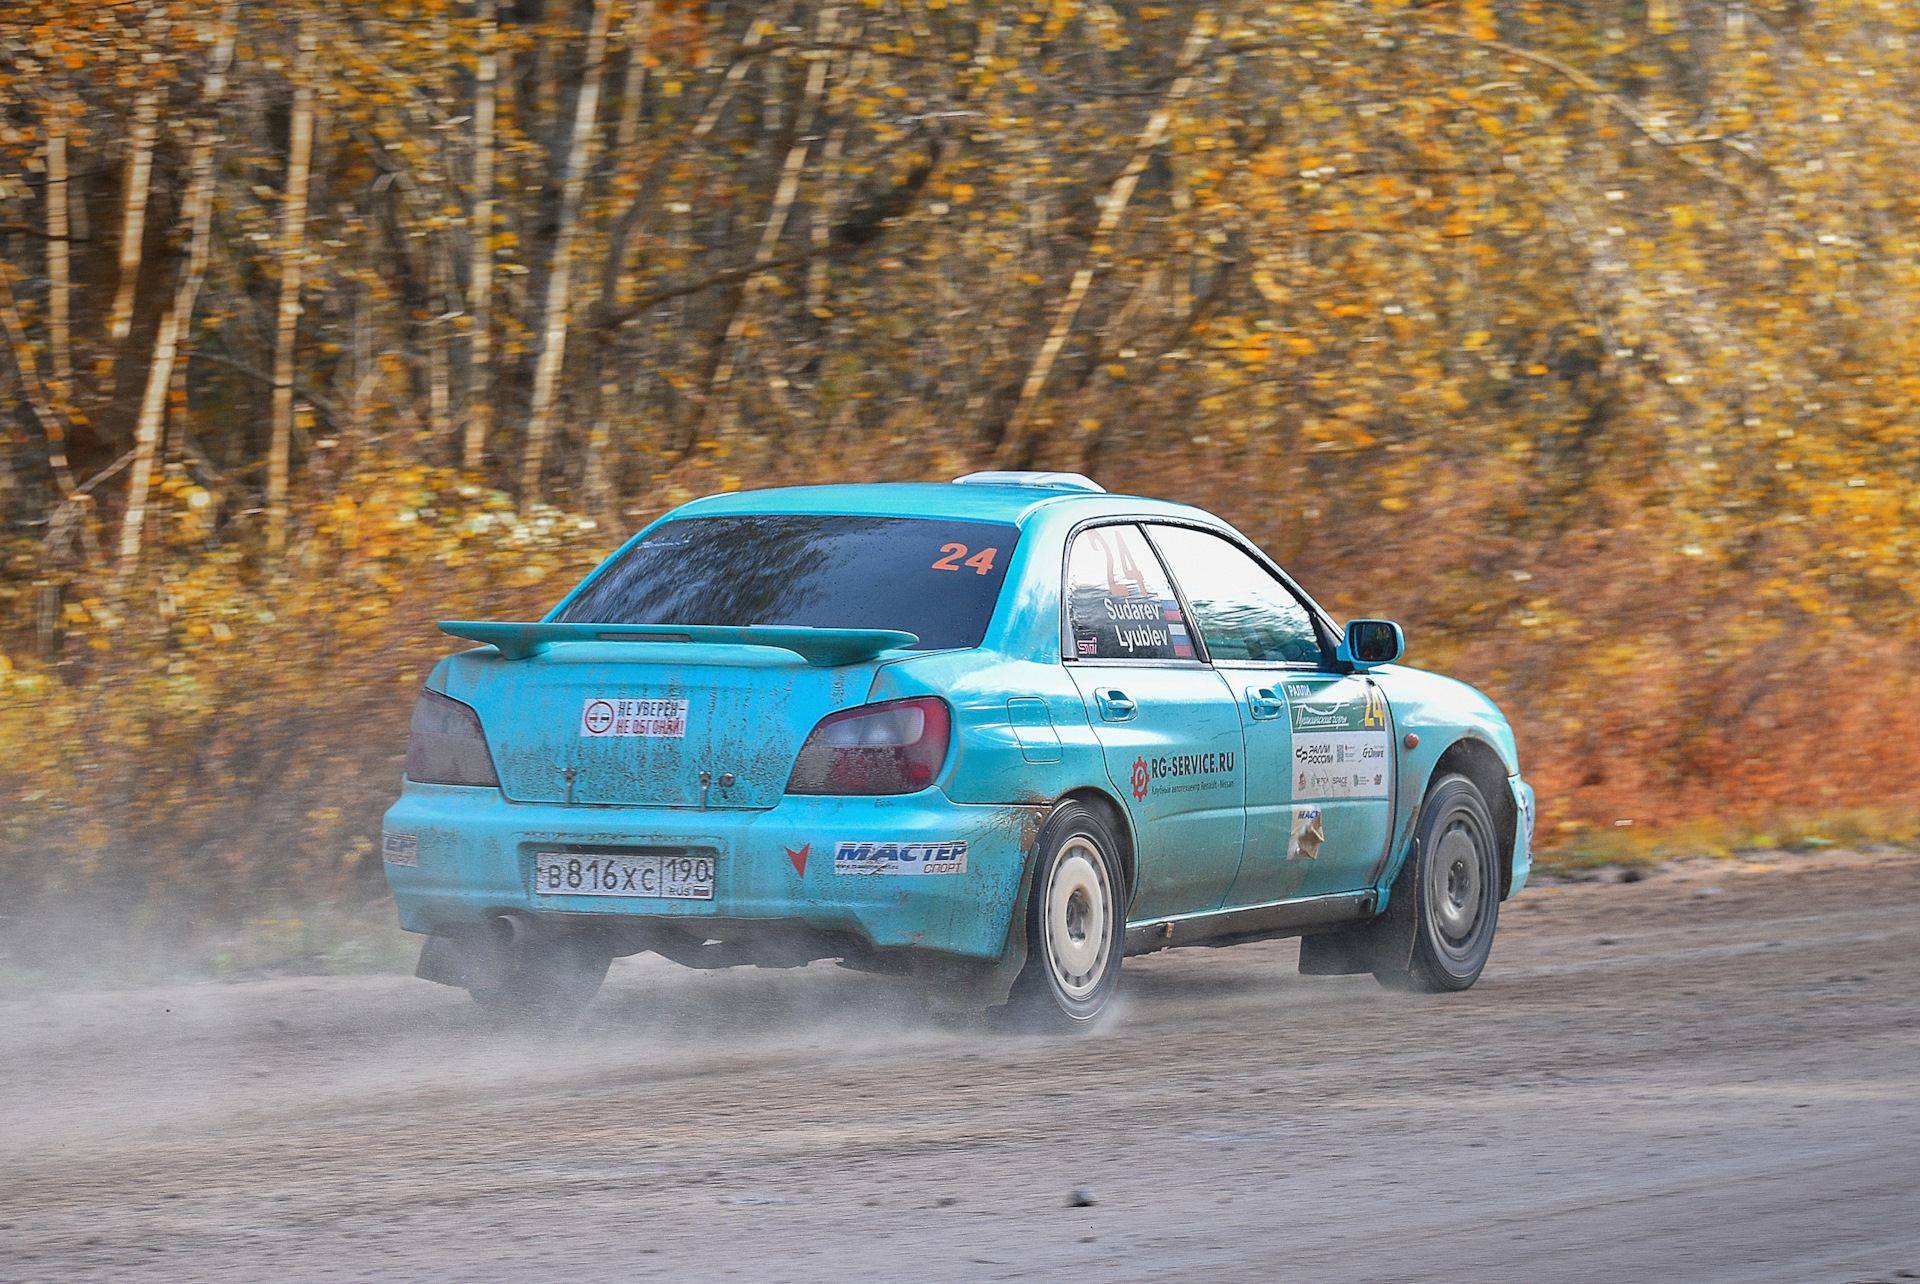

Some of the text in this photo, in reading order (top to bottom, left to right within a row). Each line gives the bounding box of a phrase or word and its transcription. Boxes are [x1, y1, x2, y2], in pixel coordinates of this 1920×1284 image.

[931, 542, 998, 576] 24
[1086, 529, 1148, 597] 24
[1103, 598, 1161, 621] Sudarev
[1114, 624, 1168, 653] Lyublev
[617, 701, 633, 718] НЕ
[1358, 685, 1384, 726] 24
[615, 719, 630, 735] НЕ
[1151, 751, 1235, 779] RG-SERVICE.RU
[835, 841, 967, 862] МАСТЕР
[664, 858, 709, 883] 190
[923, 862, 962, 874] СПОРТ
[668, 886, 691, 896] RUS
